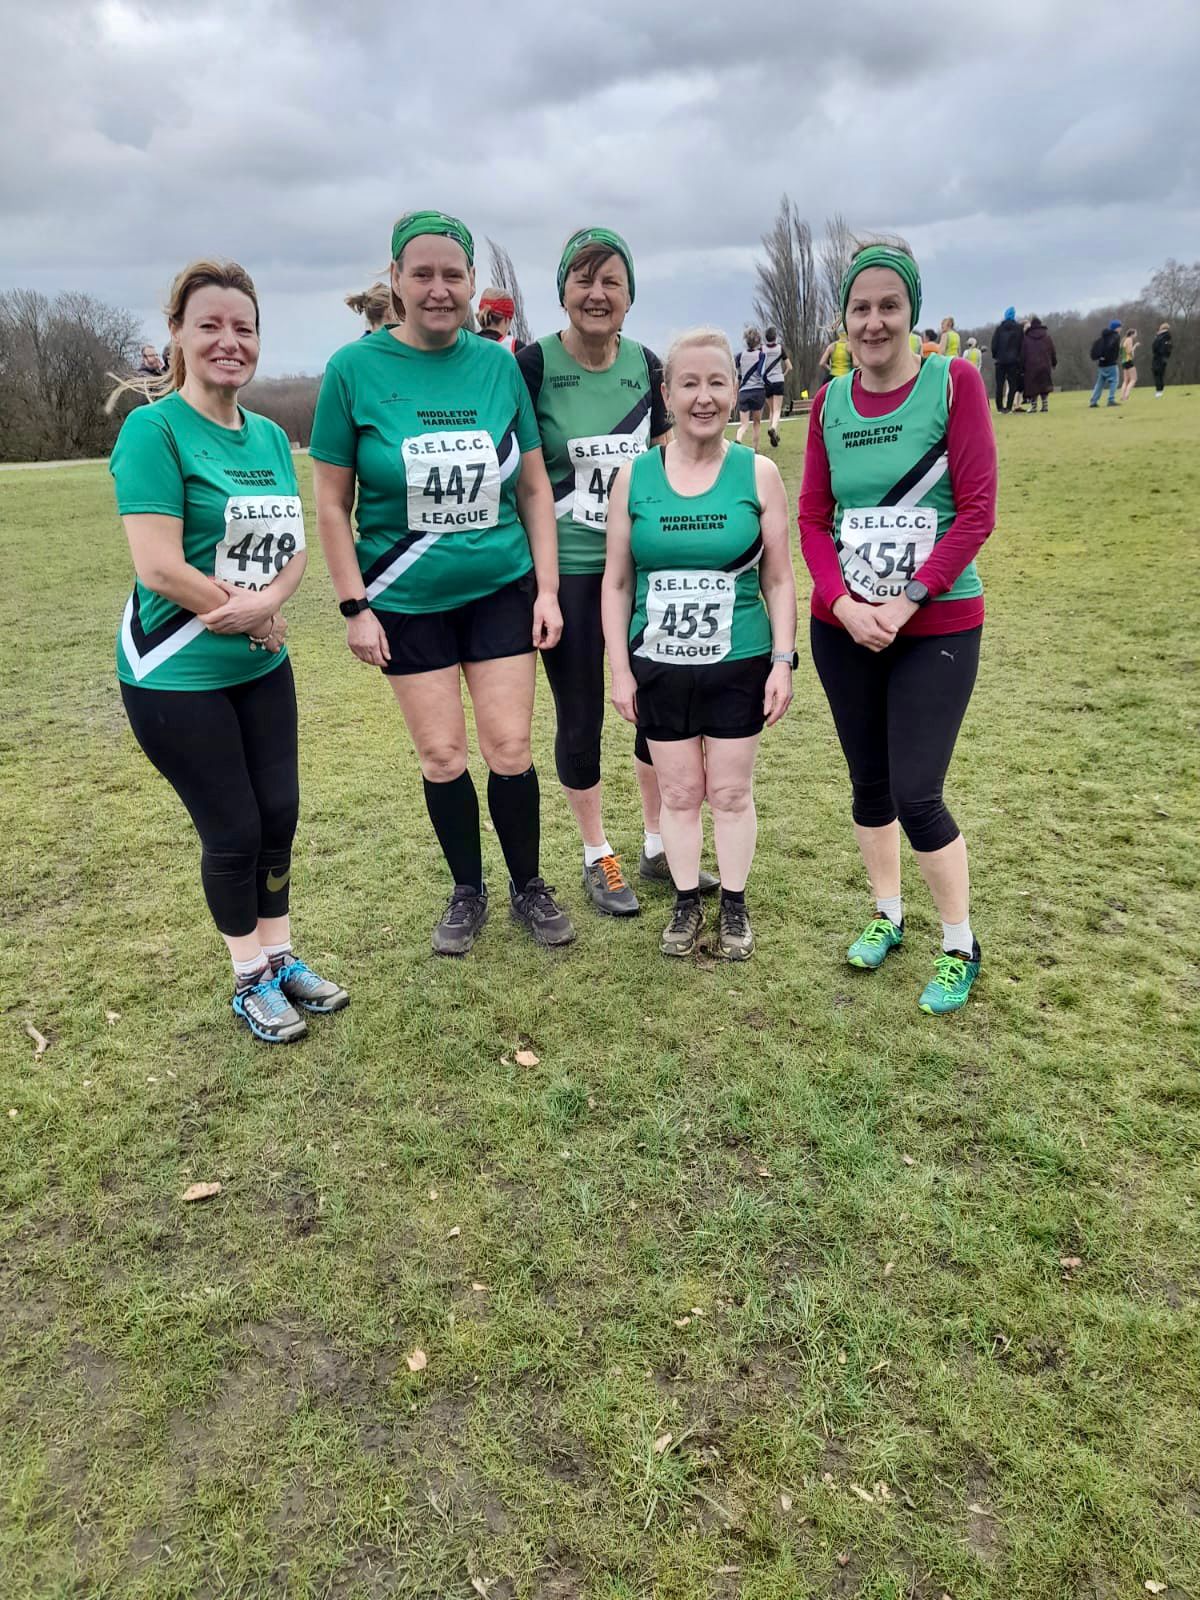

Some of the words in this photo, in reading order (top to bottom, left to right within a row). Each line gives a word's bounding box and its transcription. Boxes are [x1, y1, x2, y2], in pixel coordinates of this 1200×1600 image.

[620, 378, 641, 390] FILA
[417, 409, 478, 418] MIDDLETON
[423, 417, 477, 426] HARRIERS
[842, 424, 903, 441] MIDDLETON
[409, 438, 490, 455] S.E.L.C.C.
[845, 434, 898, 449] HARRIERS
[575, 441, 644, 458] S.E.L.C.C.
[223, 469, 275, 478] MIDDLETON
[231, 477, 277, 487] HARRIERS
[423, 462, 486, 505] 447
[230, 504, 300, 520] S.E.L.C.C.
[422, 509, 489, 525] LEAGUE
[659, 513, 728, 523] MIDDLETON
[662, 522, 725, 532] HARRIERS
[848, 515, 931, 530] S.E.L.C.C.
[227, 532, 296, 574] 448
[855, 542, 916, 581] 454
[654, 578, 731, 592] S.E.L.C.C.
[659, 602, 721, 639] 455
[656, 643, 721, 657] LEAGUE
